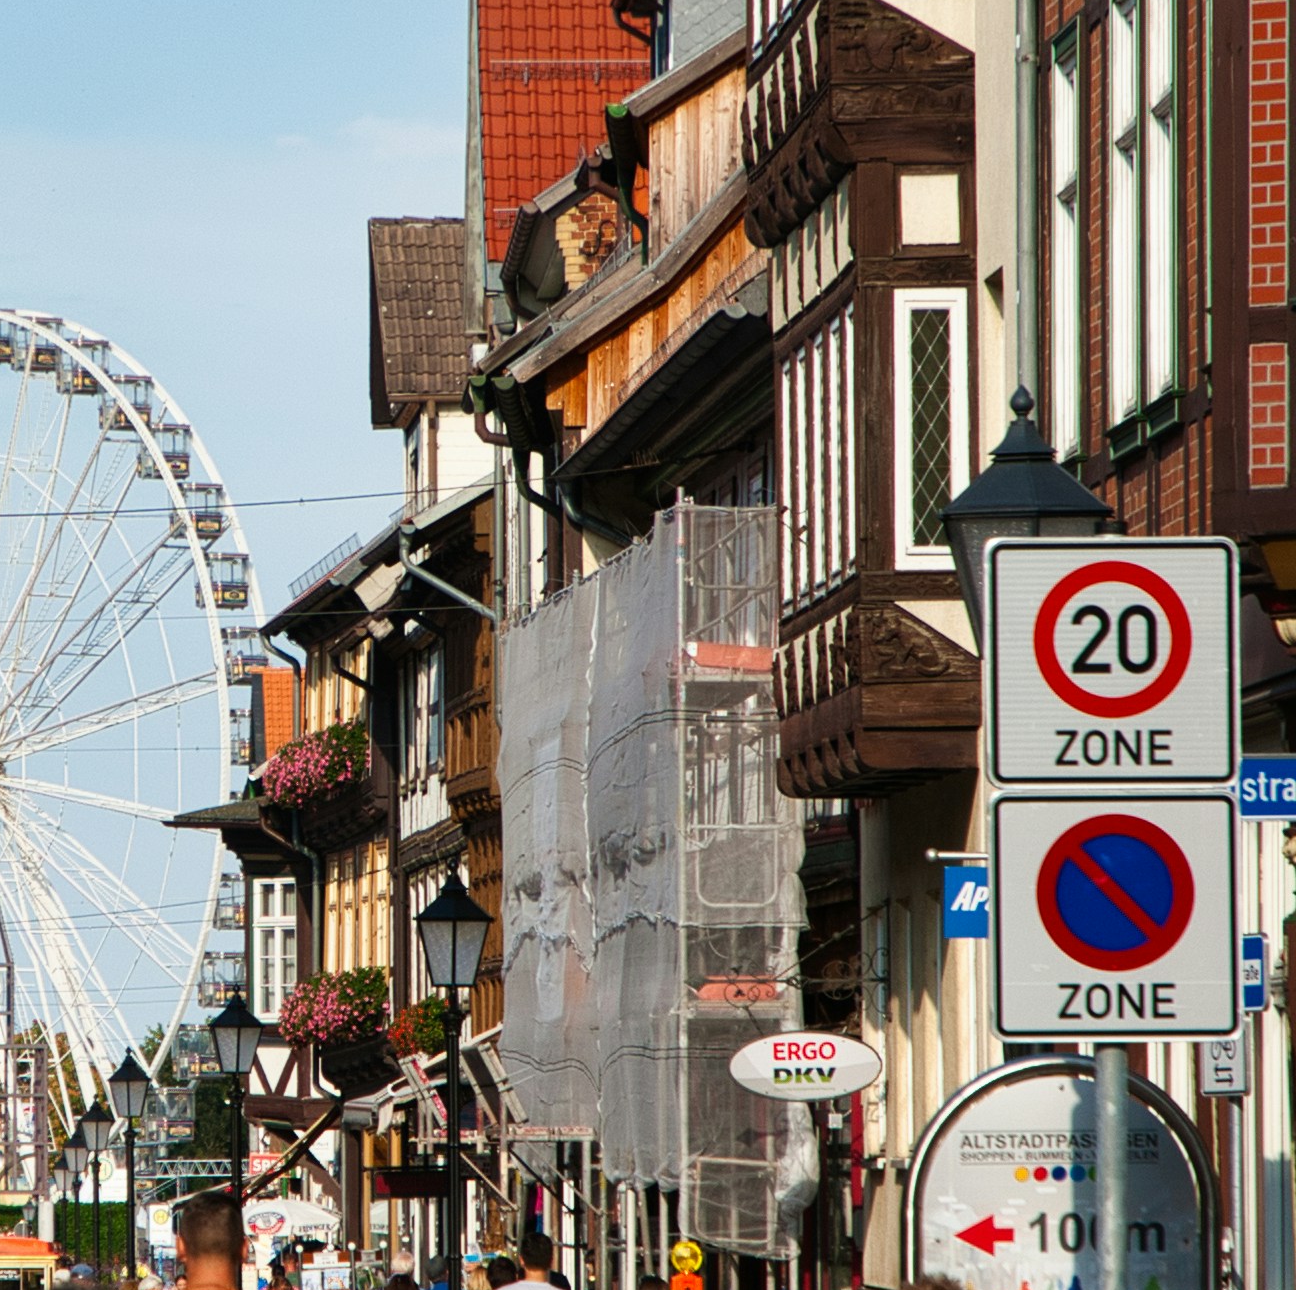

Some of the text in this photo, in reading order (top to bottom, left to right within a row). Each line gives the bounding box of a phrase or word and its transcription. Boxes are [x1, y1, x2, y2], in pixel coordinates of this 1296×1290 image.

[1071, 605, 1158, 674] 20
[1055, 729, 1173, 766] ZONE
[1058, 983, 1176, 1019] ZONE
[773, 1042, 836, 1060] ERGO
[773, 1067, 836, 1084] DKV
[960, 1133, 1158, 1150] ALTSTADTPASEN
[1127, 1221, 1165, 1252] m
